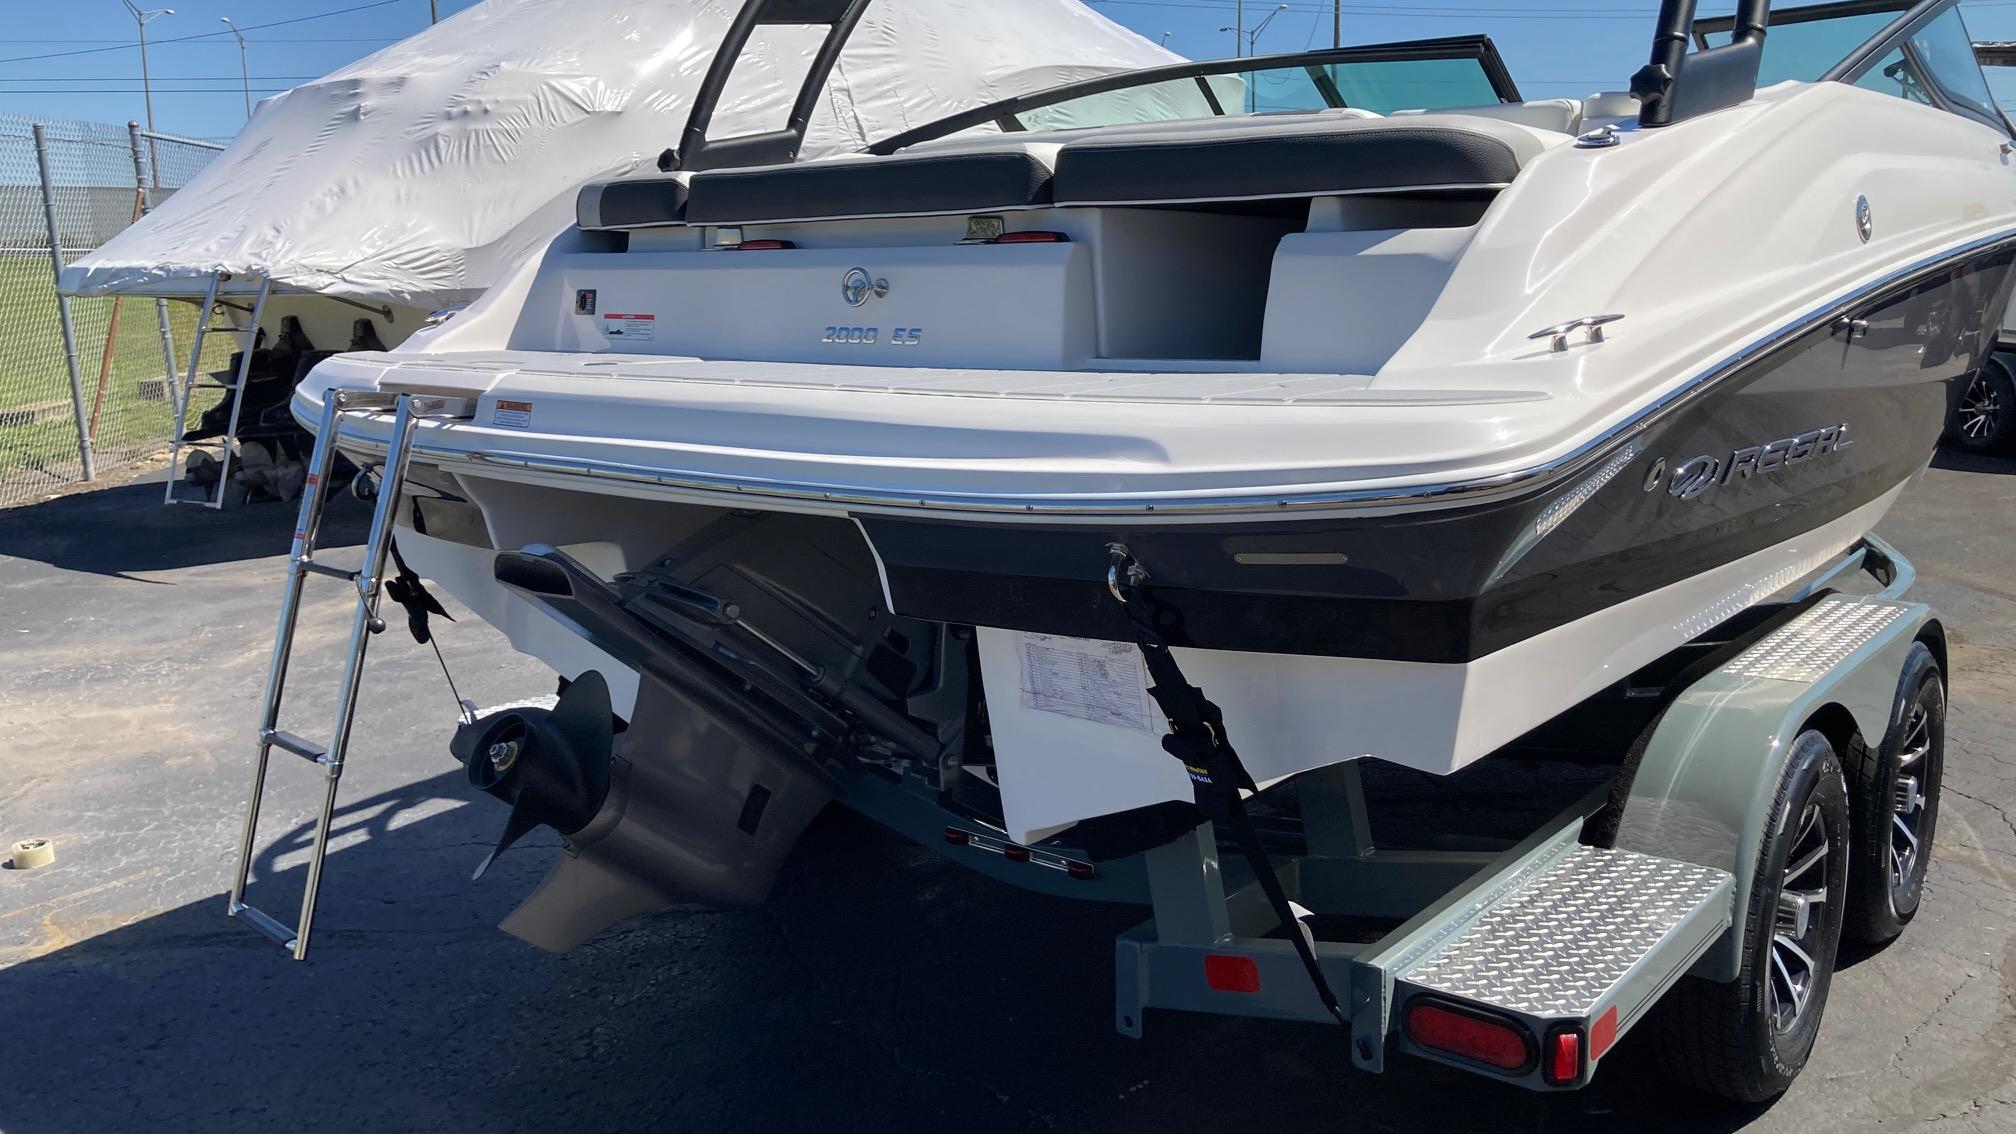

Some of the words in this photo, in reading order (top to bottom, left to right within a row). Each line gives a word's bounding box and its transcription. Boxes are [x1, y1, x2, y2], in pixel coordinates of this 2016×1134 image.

[821, 326, 879, 344] 2000
[891, 327, 922, 346] ES
[1720, 422, 1854, 486] REGAL
